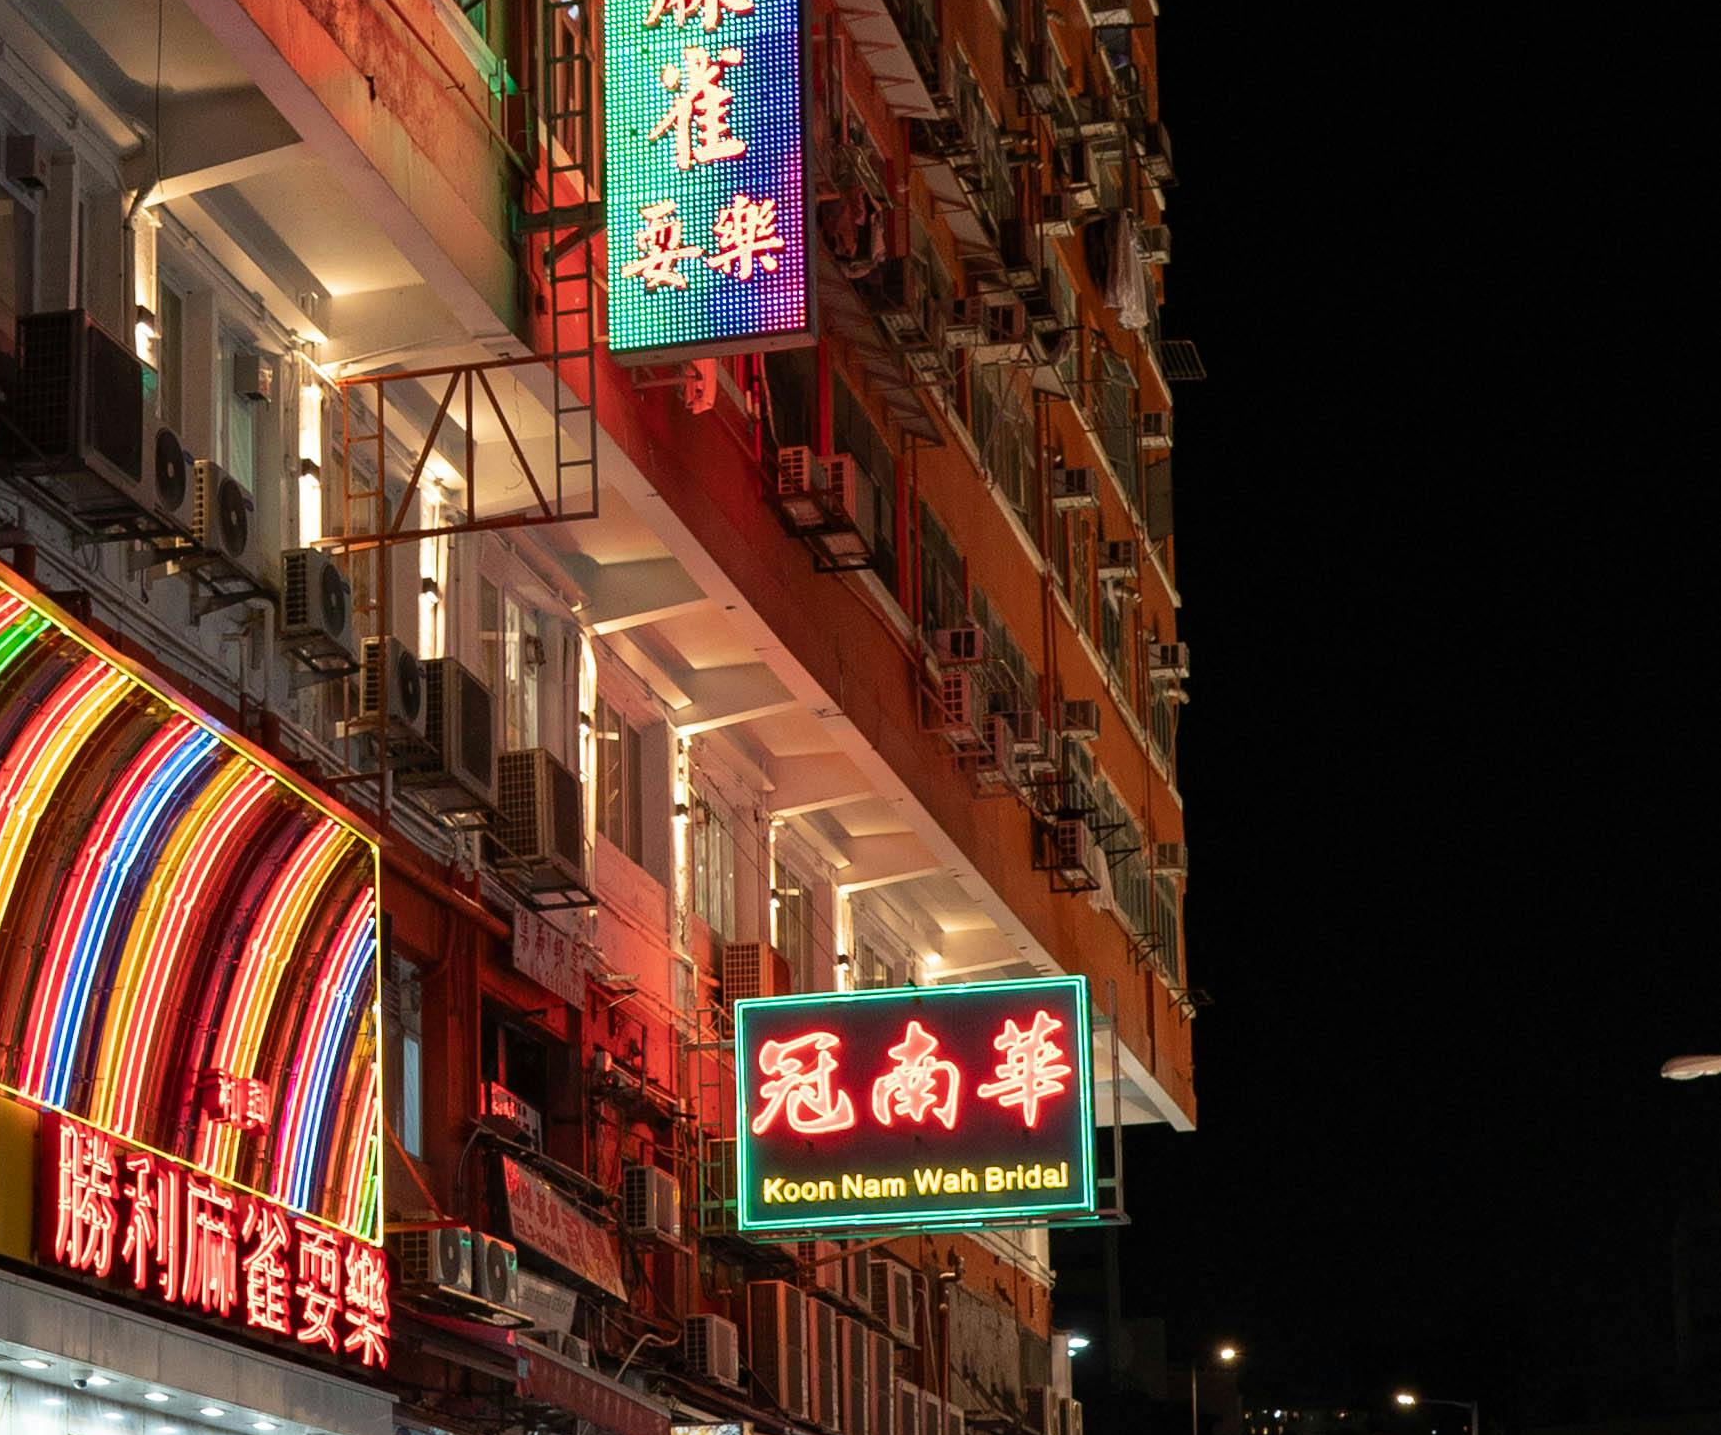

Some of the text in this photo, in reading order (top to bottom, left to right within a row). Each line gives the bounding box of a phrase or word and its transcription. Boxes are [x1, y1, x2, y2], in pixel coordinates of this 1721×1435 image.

[751, 1009, 1072, 1135] 冠南華
[763, 1162, 1069, 1204] Koon Nam Wah Bridal
